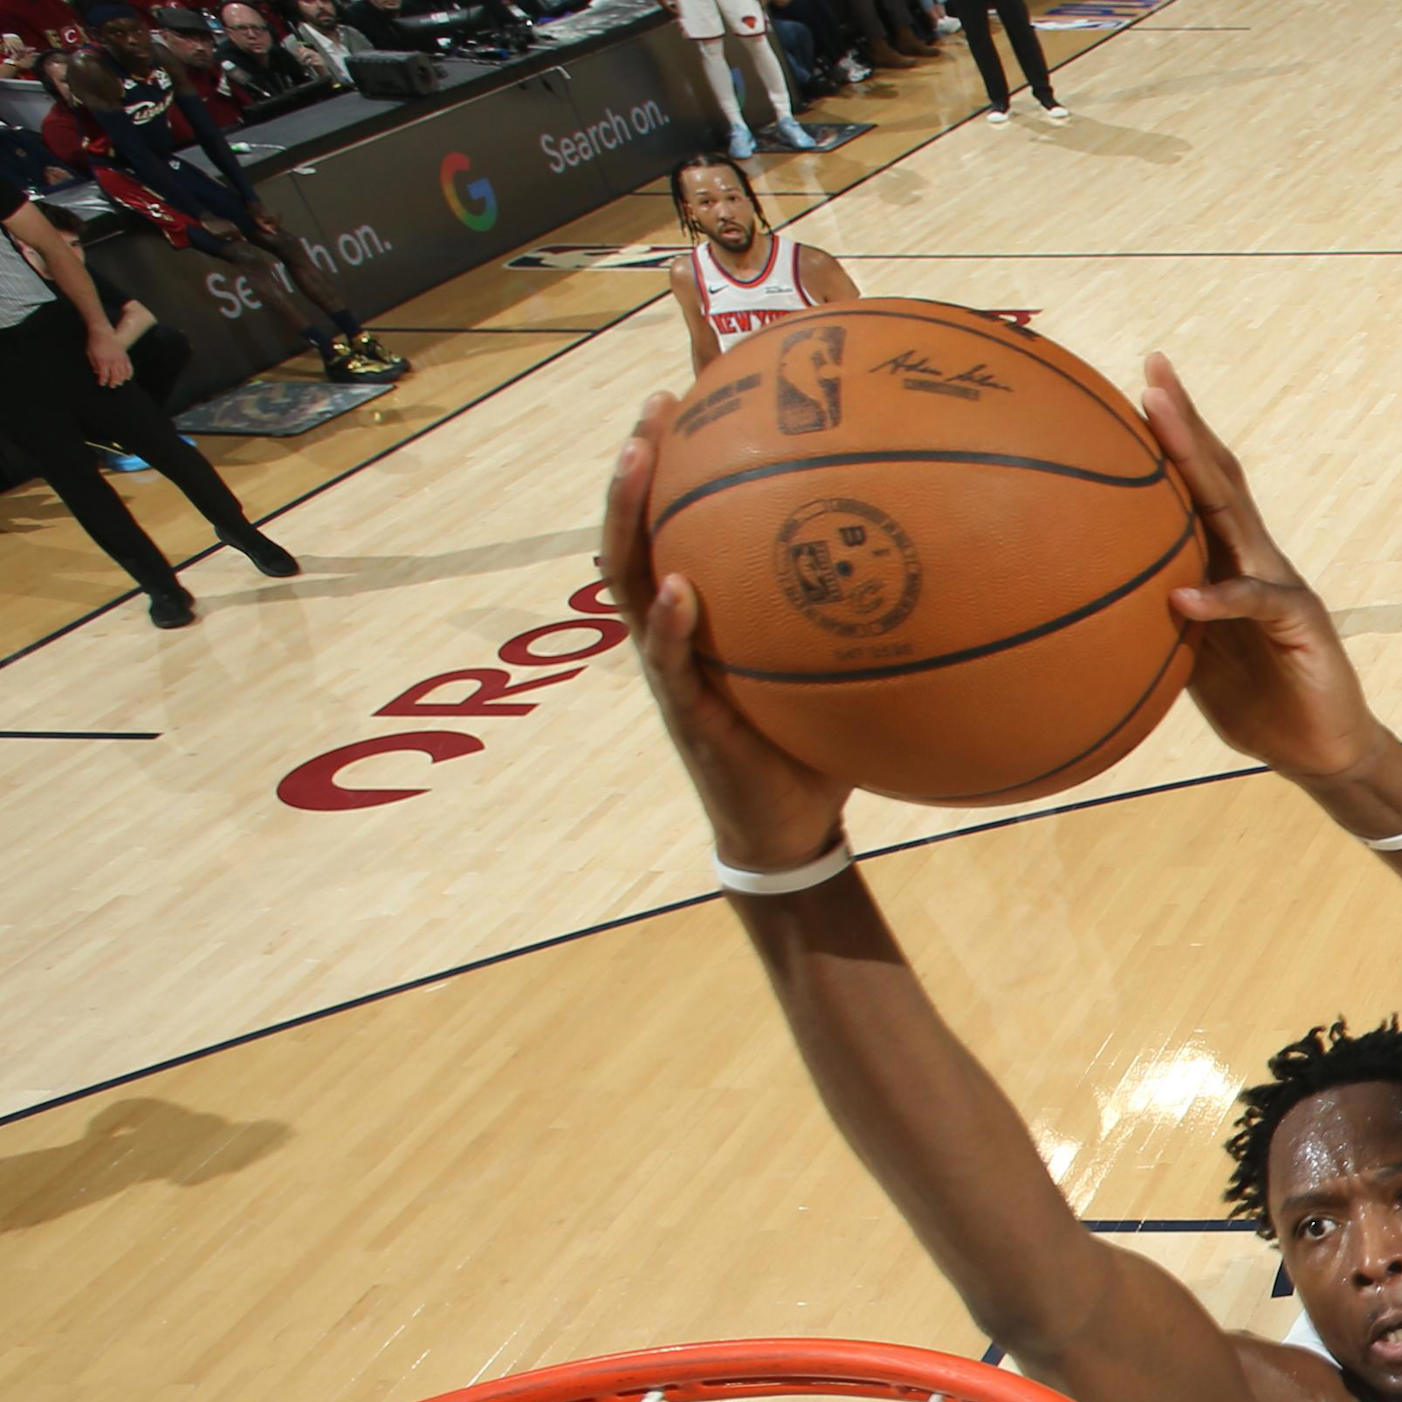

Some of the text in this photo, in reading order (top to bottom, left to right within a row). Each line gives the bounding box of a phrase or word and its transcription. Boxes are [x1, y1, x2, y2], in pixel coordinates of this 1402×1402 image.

[540, 99, 670, 174] Search on.
[206, 224, 392, 319] Serh on.
